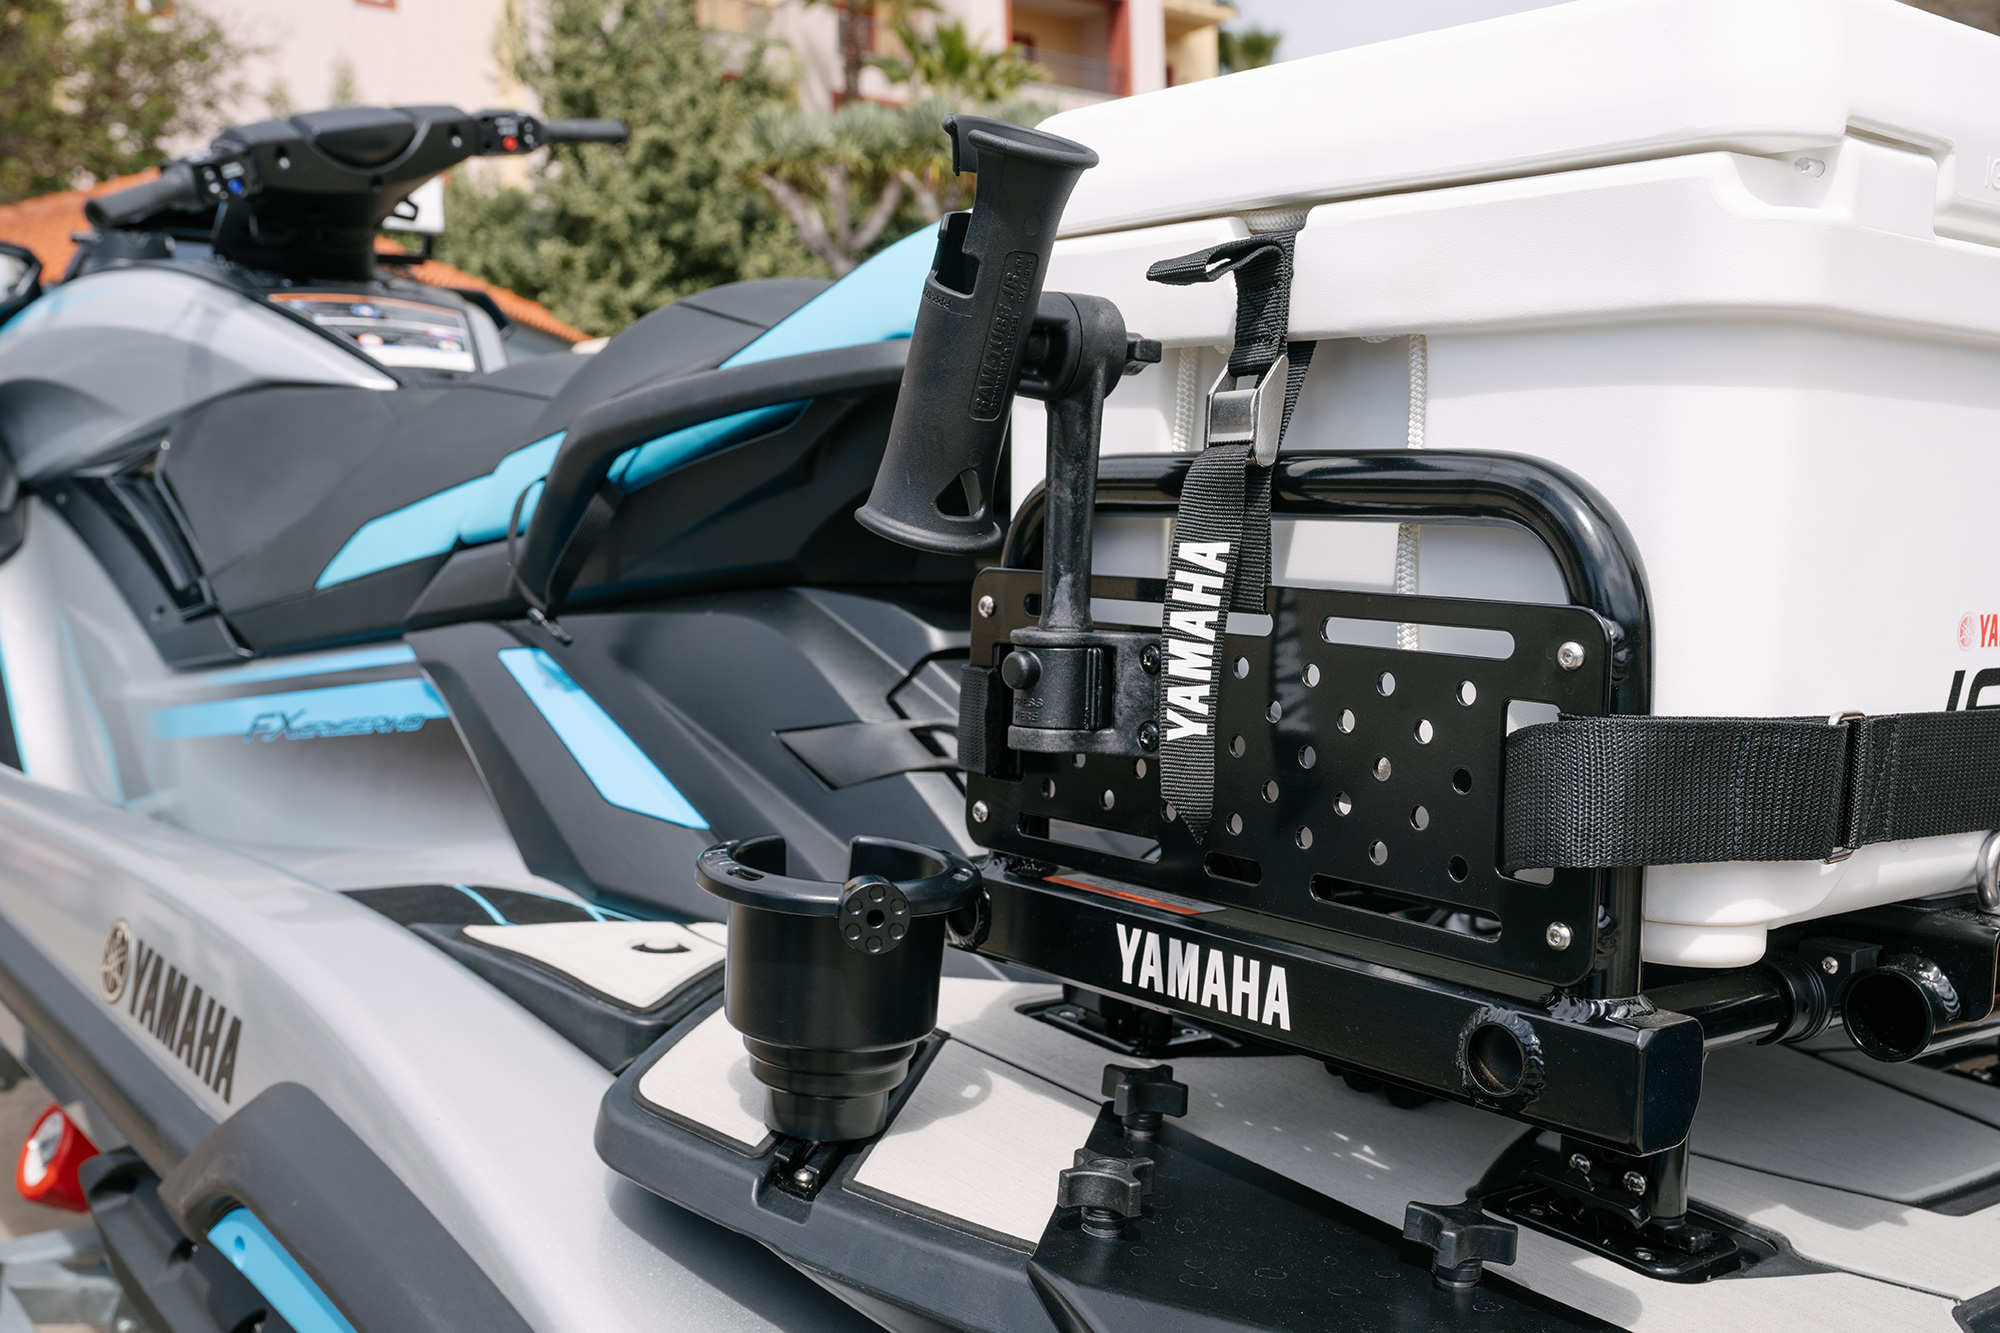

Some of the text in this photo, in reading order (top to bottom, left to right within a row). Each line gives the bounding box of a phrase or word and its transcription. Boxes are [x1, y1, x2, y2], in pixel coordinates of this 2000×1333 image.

[1166, 542, 1231, 741] YAMAHA
[1980, 613, 2000, 648] YA
[128, 939, 242, 1105] YAMAHA
[1116, 922, 1291, 1031] YAMAHA
